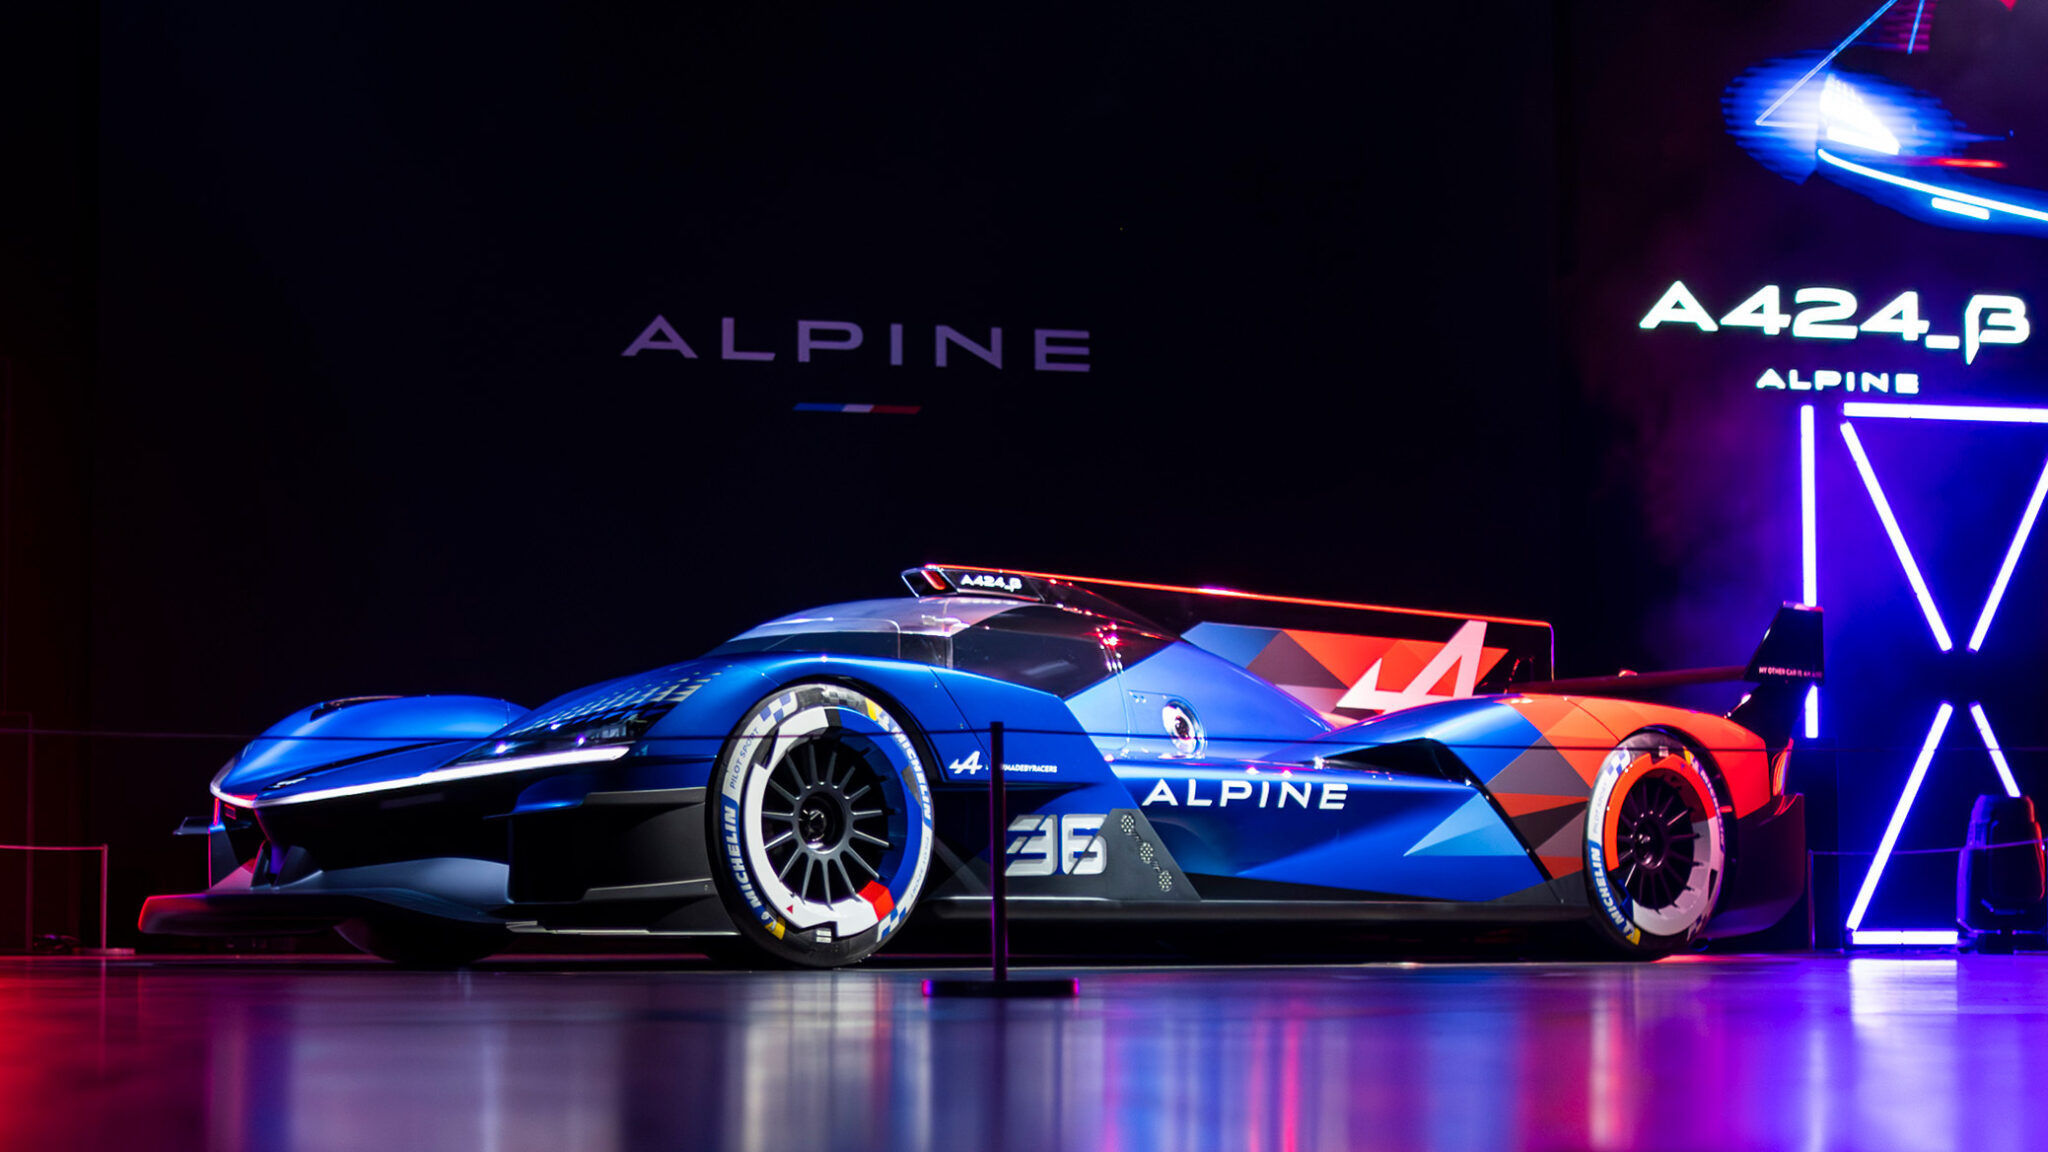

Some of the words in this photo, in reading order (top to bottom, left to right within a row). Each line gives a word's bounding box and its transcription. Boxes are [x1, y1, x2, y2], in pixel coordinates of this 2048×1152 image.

[620, 313, 1092, 373] ALPINE
[1755, 367, 1920, 395] ALPINE
[729, 759, 743, 790] PILOT
[739, 727, 759, 759] SPORT
[890, 725, 933, 821] MICHELIN
[1141, 778, 1349, 811] ALPINE
[724, 804, 763, 909] MICHELIN
[1003, 813, 1108, 878] 36
[1590, 846, 1625, 926] MICHELIN
